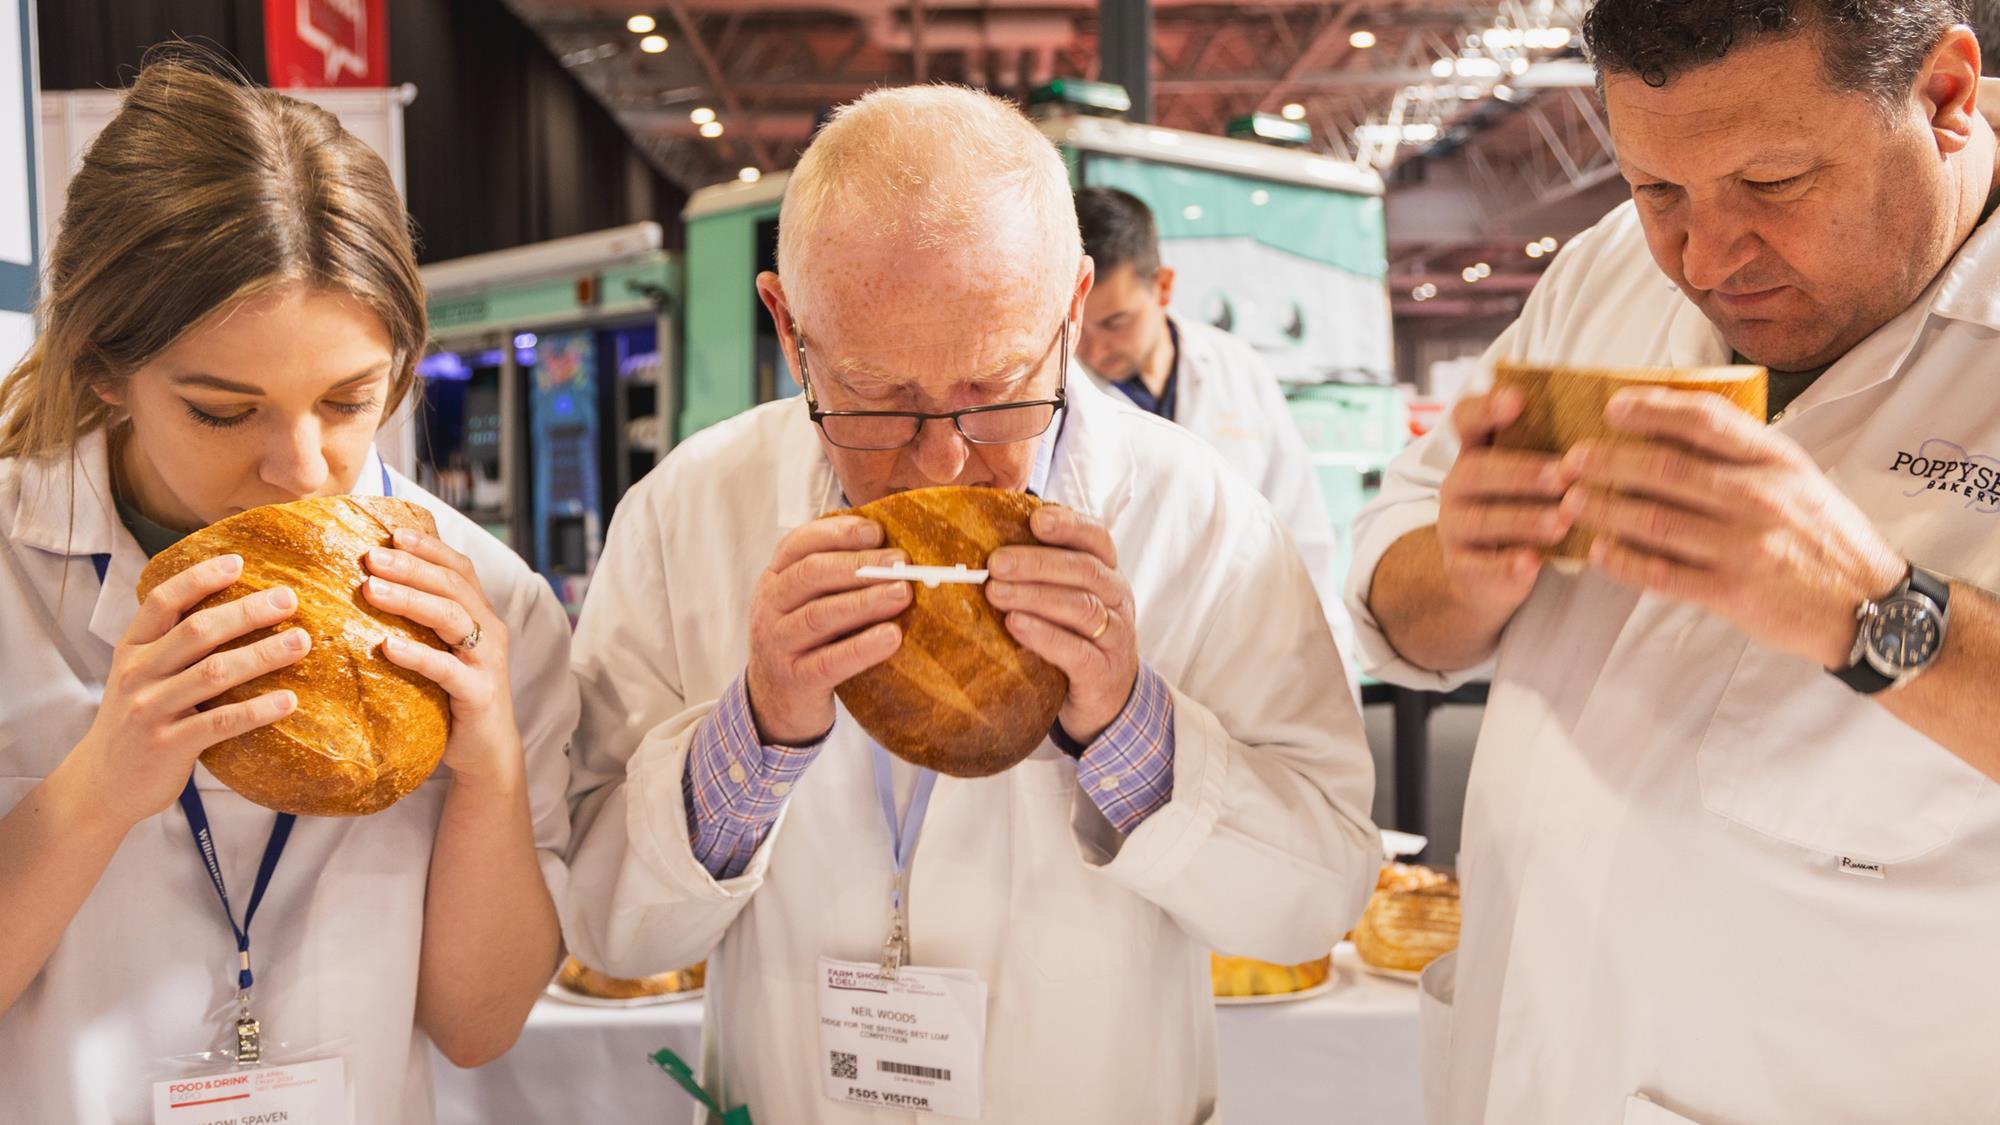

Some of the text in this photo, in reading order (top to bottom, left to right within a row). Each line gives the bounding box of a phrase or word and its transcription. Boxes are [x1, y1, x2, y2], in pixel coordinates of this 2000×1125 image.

[1927, 480, 1999, 506] BAKERY
[827, 968, 853, 978] FARM
[835, 977, 857, 986] DELI
[851, 1006, 917, 1024] NEIL WOODS
[860, 1031, 908, 1044] COMPETITION
[861, 1023, 873, 1031] THE
[910, 1030, 928, 1039] BEST
[930, 1032, 949, 1041] LOAF
[169, 1082, 204, 1093] FOOD
[205, 1081, 212, 1089] &
[214, 1075, 249, 1088] DRINK
[848, 1087, 878, 1099] FSDS
[882, 1092, 929, 1107] VISITOR
[241, 1111, 288, 1125] SPAVEN
